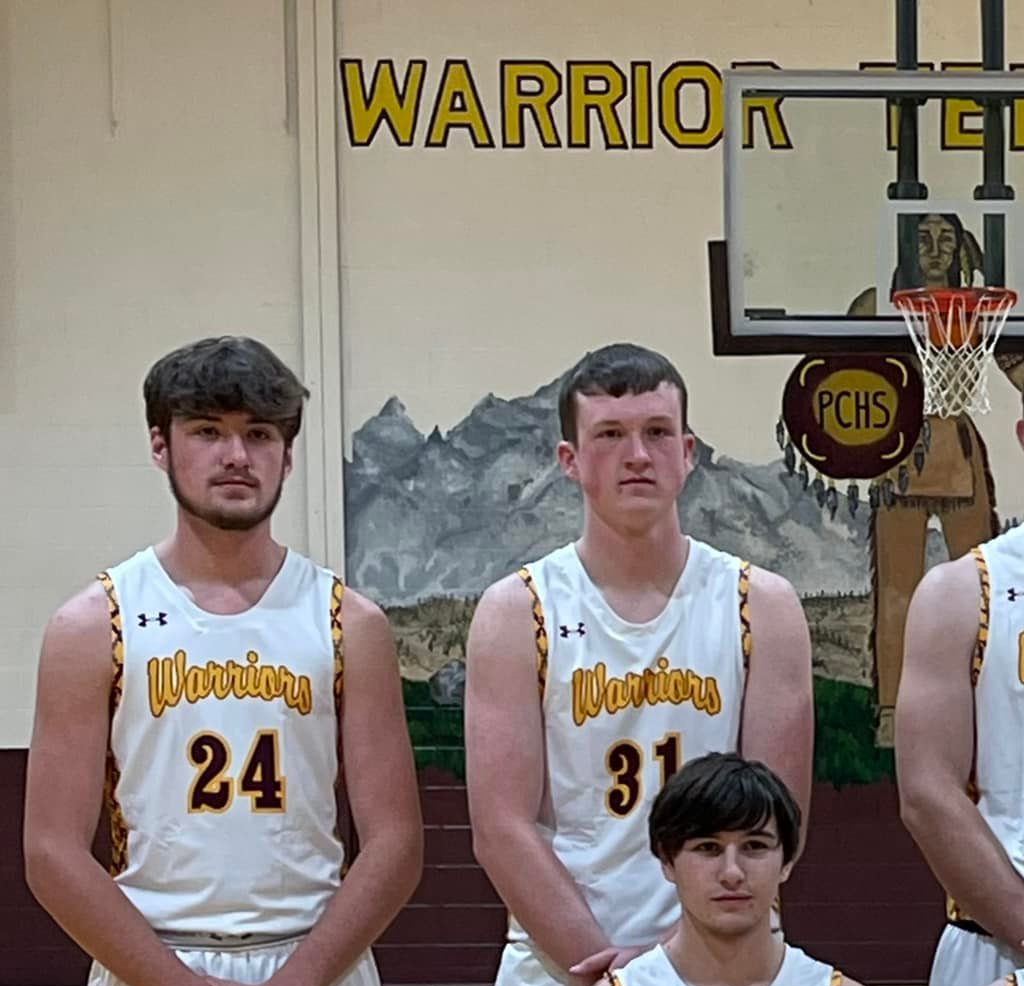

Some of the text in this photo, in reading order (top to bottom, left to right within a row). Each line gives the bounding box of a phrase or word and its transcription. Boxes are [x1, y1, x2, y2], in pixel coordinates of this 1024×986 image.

[340, 59, 793, 150] WARRIOR
[817, 389, 892, 432] PCHS
[147, 649, 313, 718] Warriors
[572, 656, 722, 726] Warriors
[187, 728, 287, 814] 24
[605, 731, 683, 820] 31
